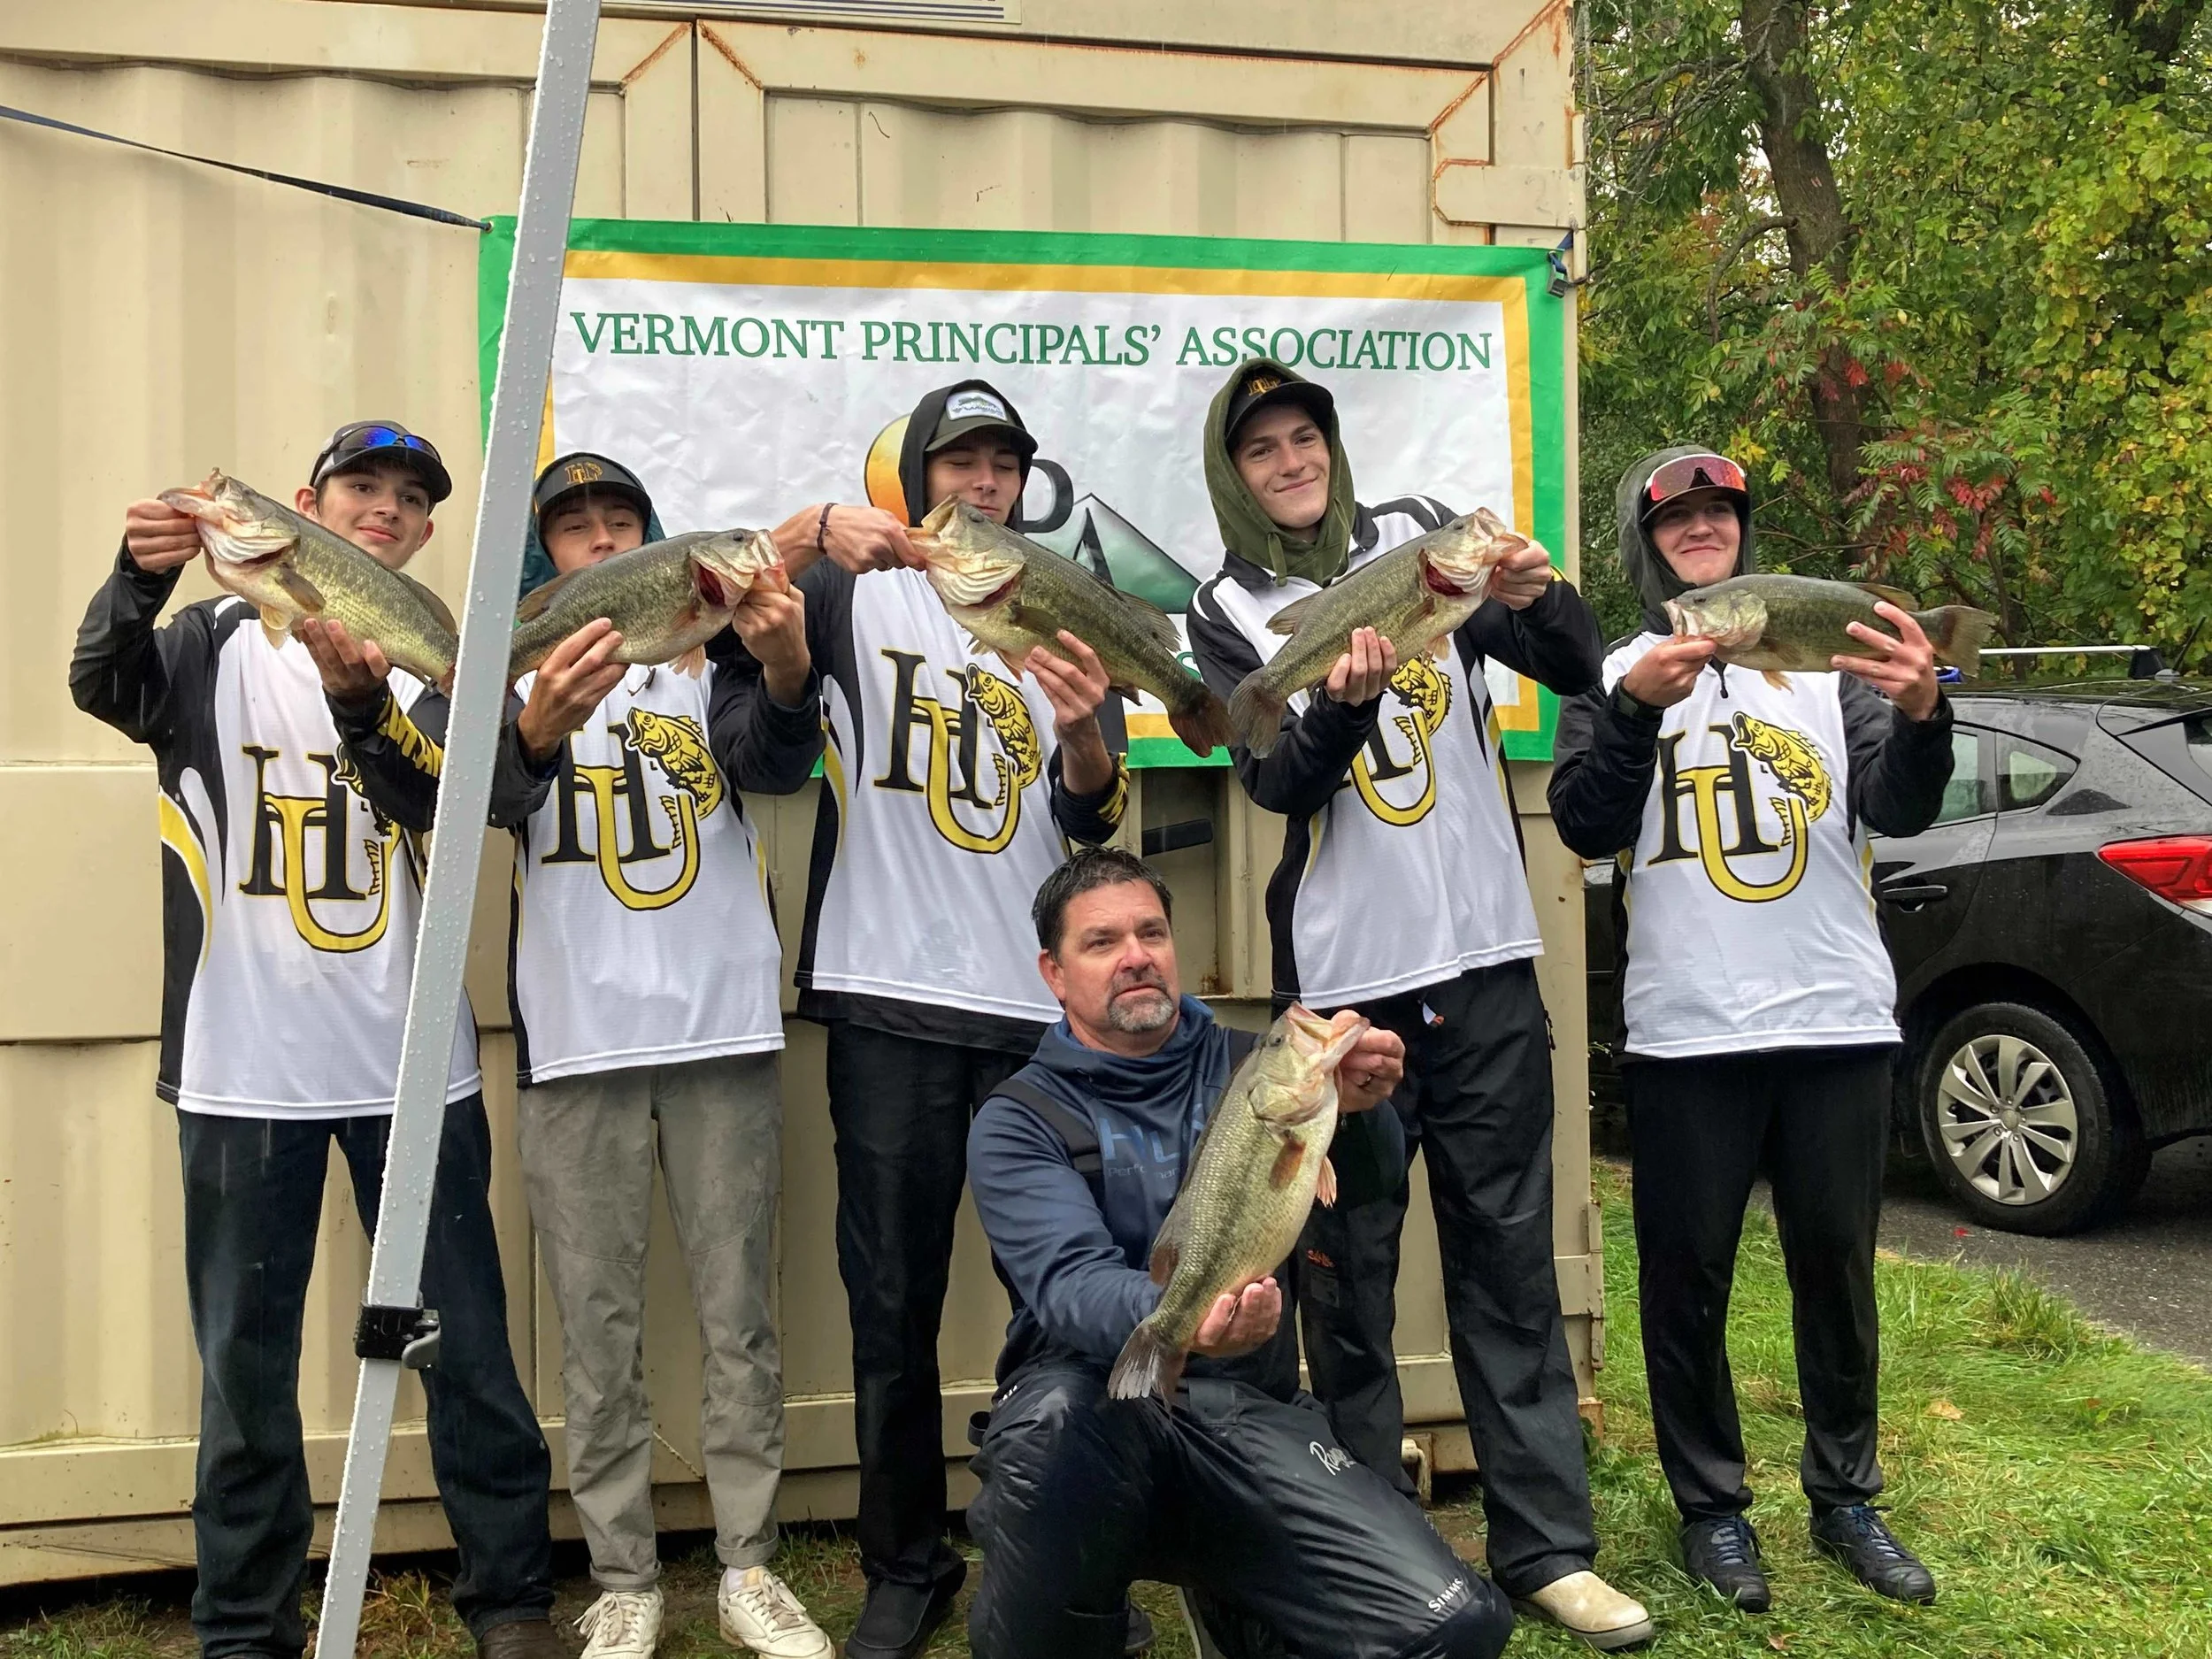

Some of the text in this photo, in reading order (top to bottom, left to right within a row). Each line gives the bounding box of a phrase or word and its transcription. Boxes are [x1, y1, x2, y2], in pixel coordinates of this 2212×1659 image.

[569, 311, 844, 359] VERMONT
[1176, 326, 1493, 372] ASSOCIATION
[1428, 1578, 1464, 1612] SIMMS
